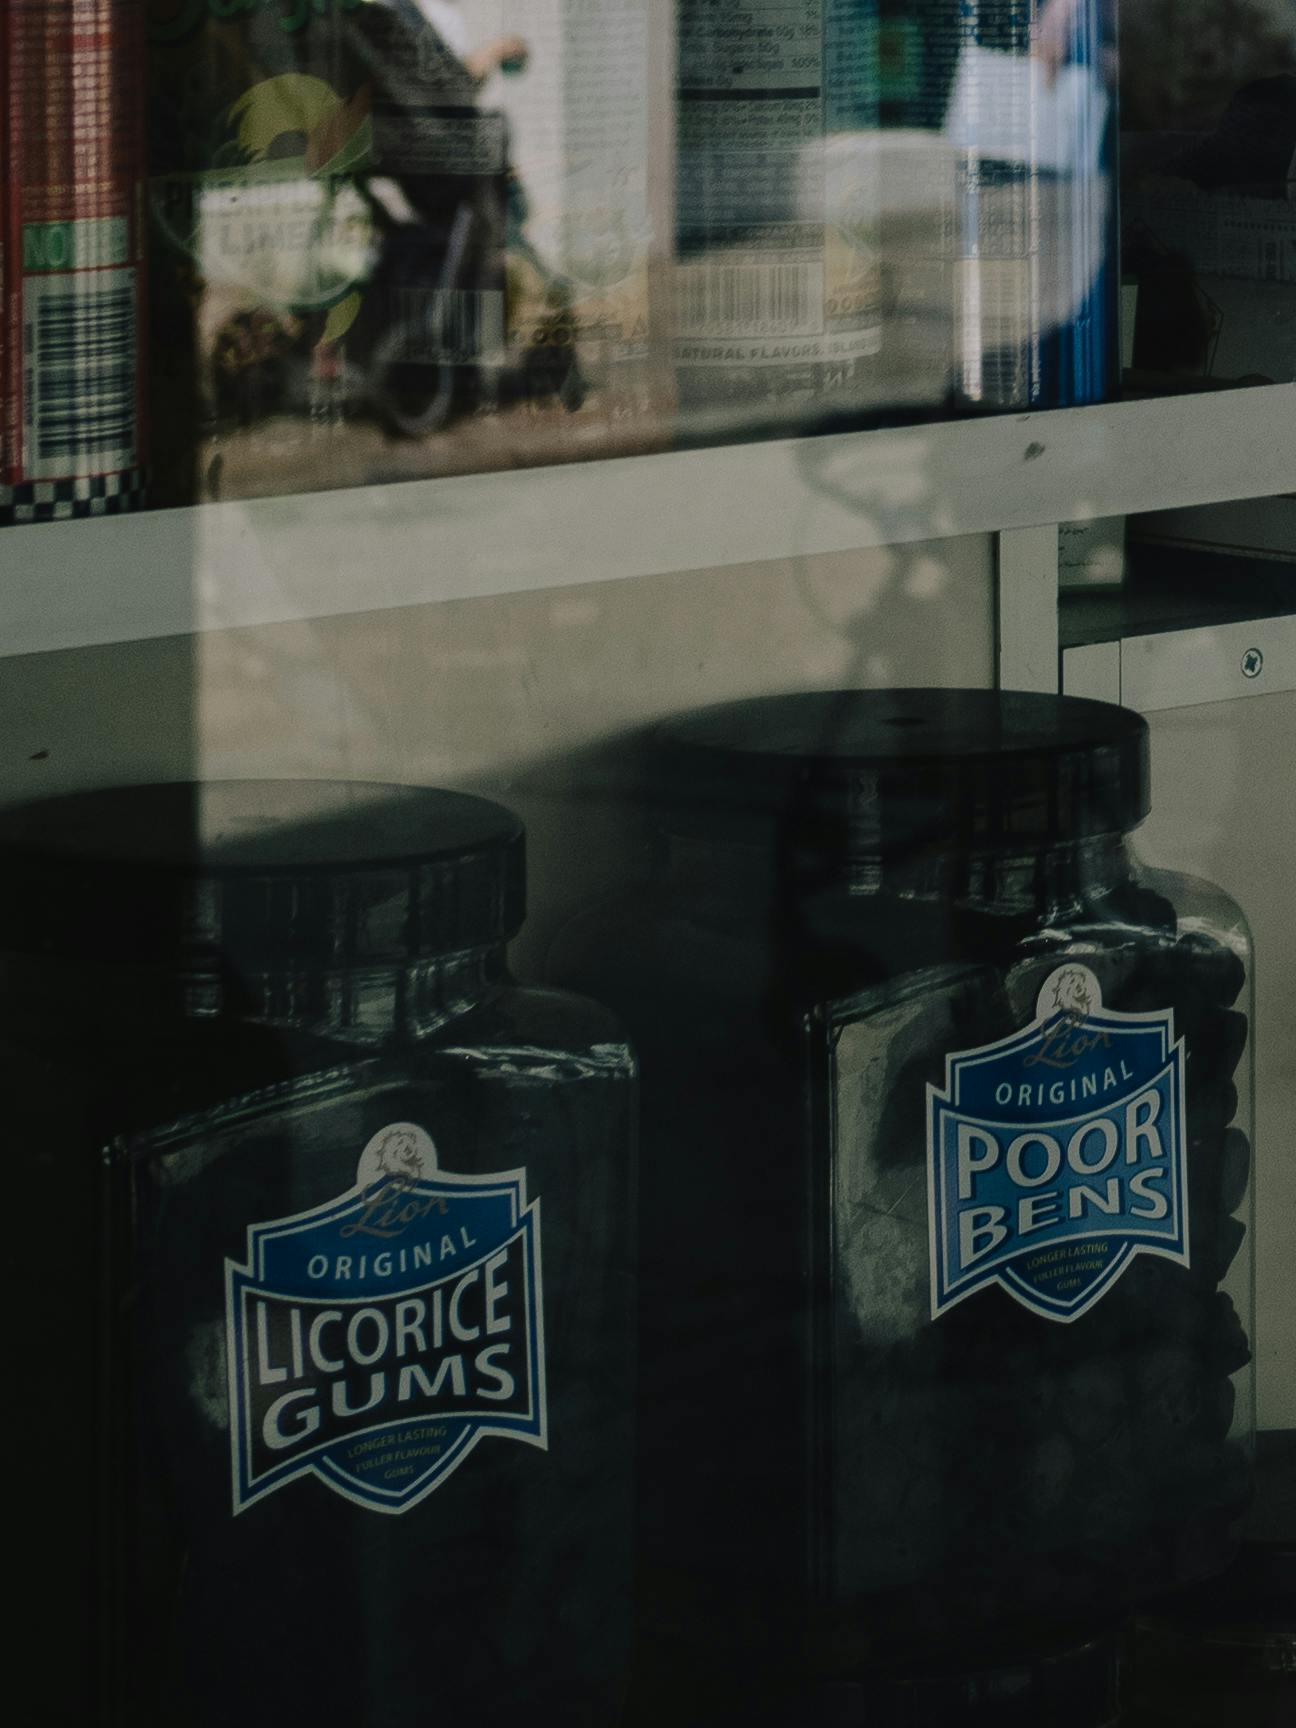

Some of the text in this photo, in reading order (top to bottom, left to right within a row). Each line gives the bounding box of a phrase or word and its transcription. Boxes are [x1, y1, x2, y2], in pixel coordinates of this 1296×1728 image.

[994, 1059, 1135, 1107] ORIGINAL
[957, 1086, 1166, 1201] POOR
[958, 1165, 1169, 1271] BENS
[306, 1225, 479, 1281] ORIGINAL
[1067, 1241, 1110, 1257] LASTING
[256, 1246, 514, 1386] LICORICE
[261, 1342, 517, 1452] GUMS
[346, 1424, 449, 1459] LONGER LASTING
[352, 1443, 443, 1474] FULLER FLAVOUR
[383, 1465, 417, 1482] GUMS
